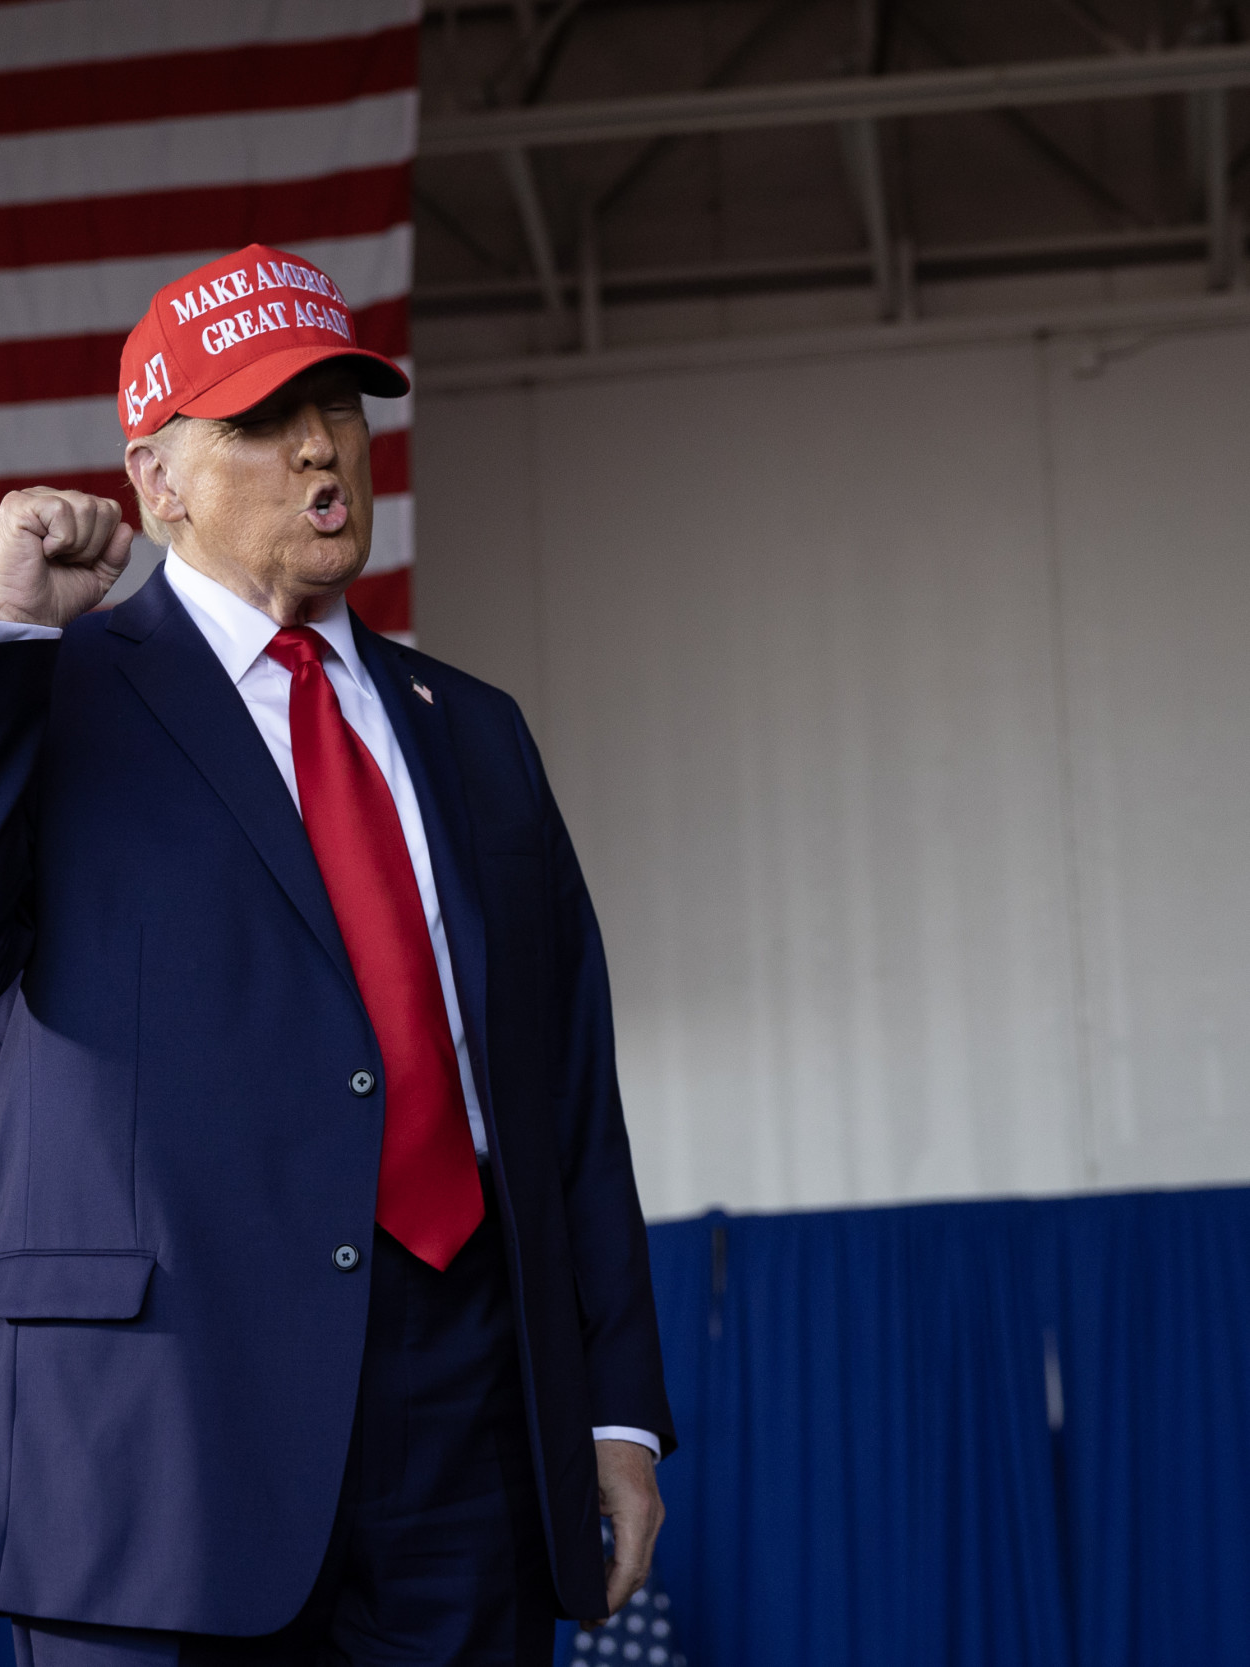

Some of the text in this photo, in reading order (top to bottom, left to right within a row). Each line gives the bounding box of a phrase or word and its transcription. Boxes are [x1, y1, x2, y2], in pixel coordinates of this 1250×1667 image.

[170, 268, 254, 325] MAKE
[202, 299, 351, 355] GREAT AGAIN
[124, 352, 172, 427] 45-47
